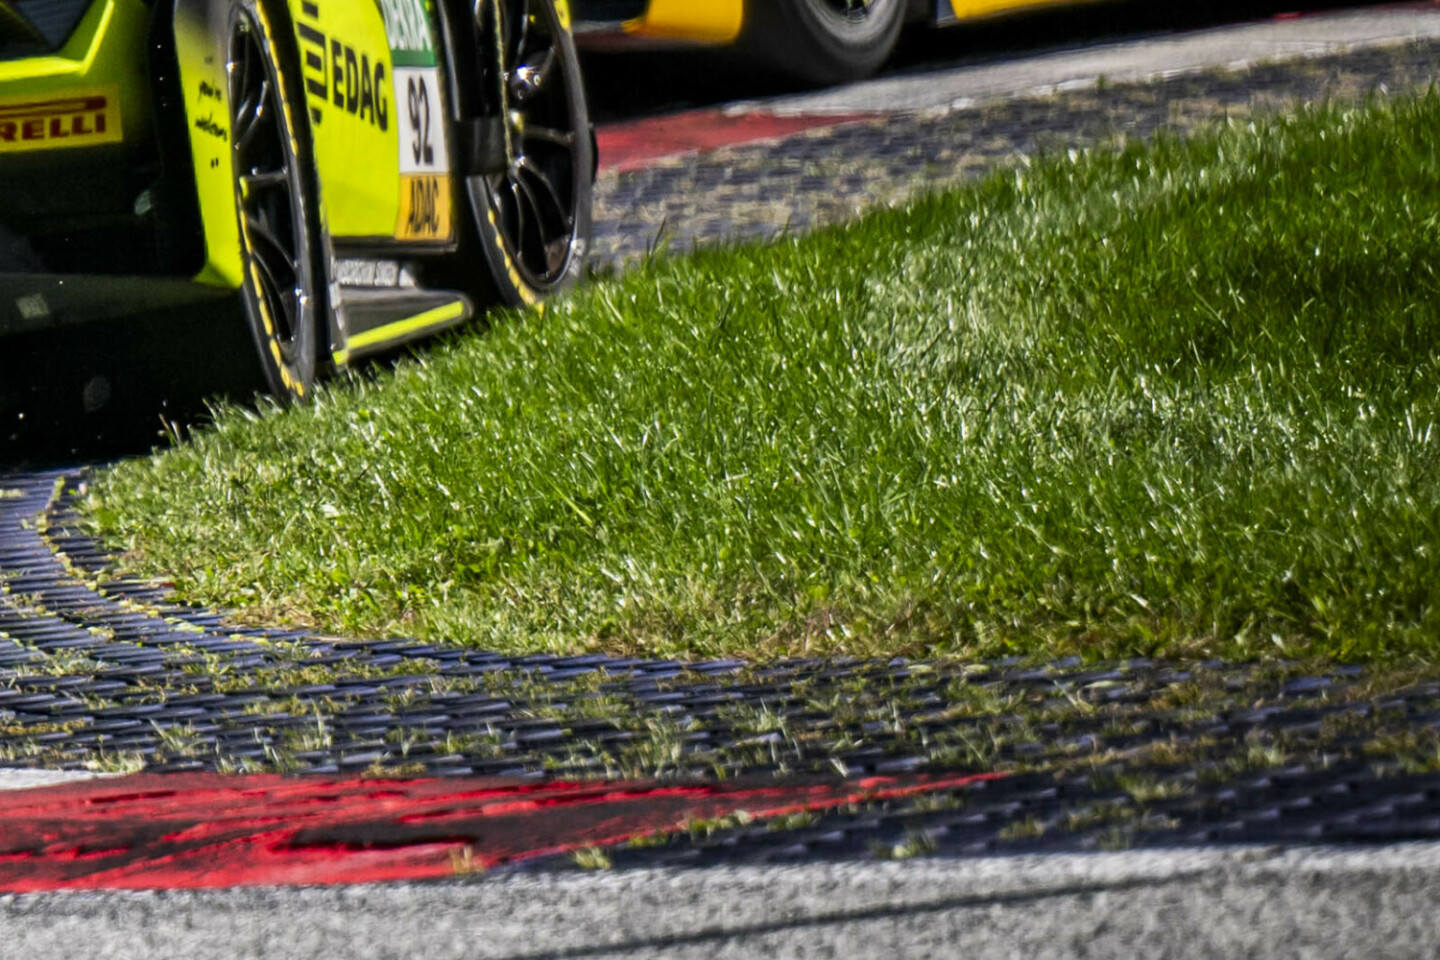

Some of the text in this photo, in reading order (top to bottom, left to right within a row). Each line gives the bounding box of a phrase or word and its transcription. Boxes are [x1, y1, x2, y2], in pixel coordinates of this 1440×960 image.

[331, 38, 388, 132] EDAG
[407, 74, 434, 166] 92
[405, 179, 440, 237] ADAC
